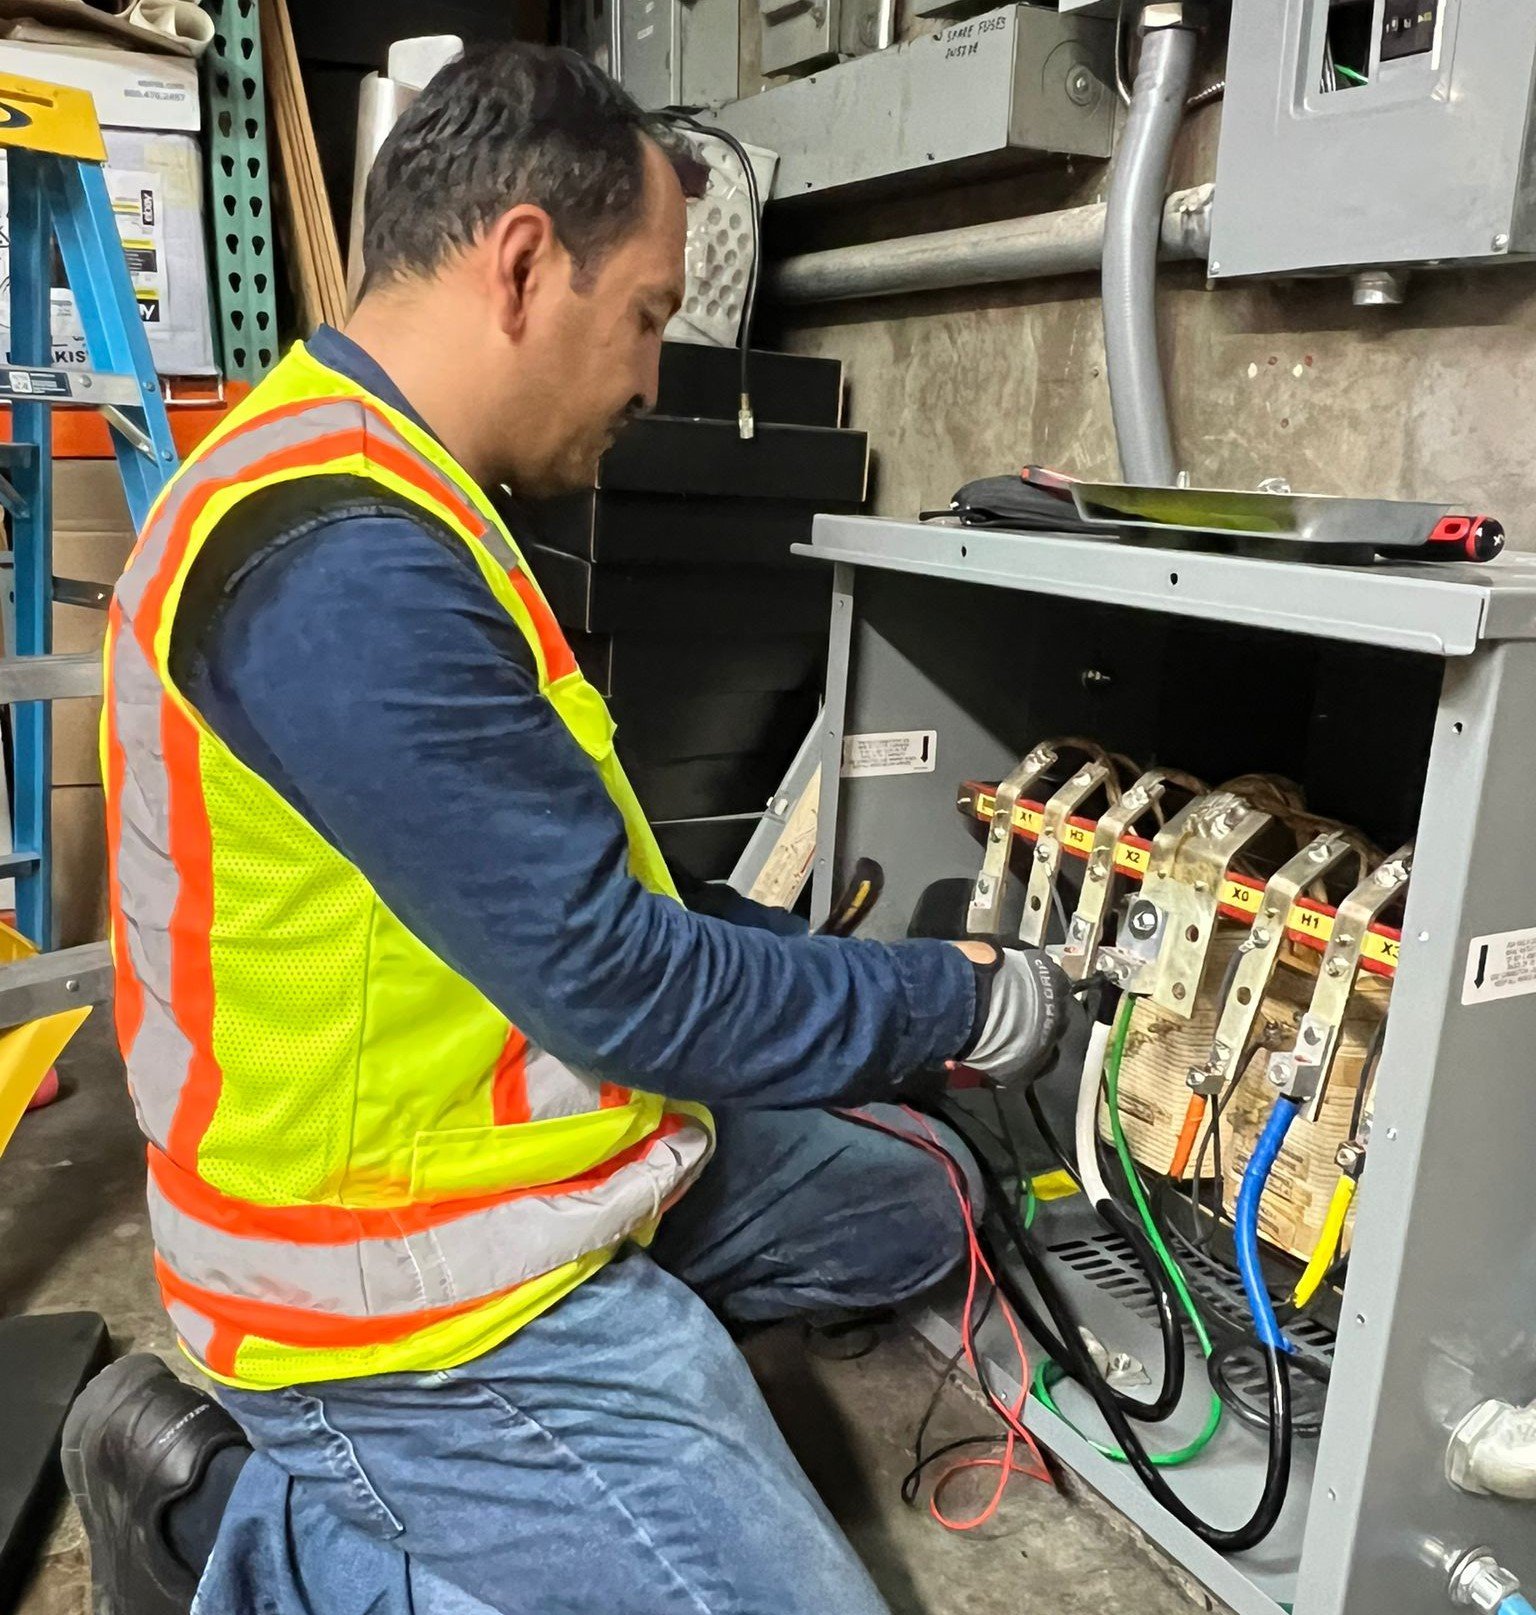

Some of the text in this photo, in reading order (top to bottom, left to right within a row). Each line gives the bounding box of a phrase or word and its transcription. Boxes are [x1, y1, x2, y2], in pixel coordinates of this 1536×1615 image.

[1019, 811, 1033, 824] X1
[1070, 829, 1084, 842] H3
[1125, 850, 1141, 863] X2
[1301, 913, 1319, 929] H1
